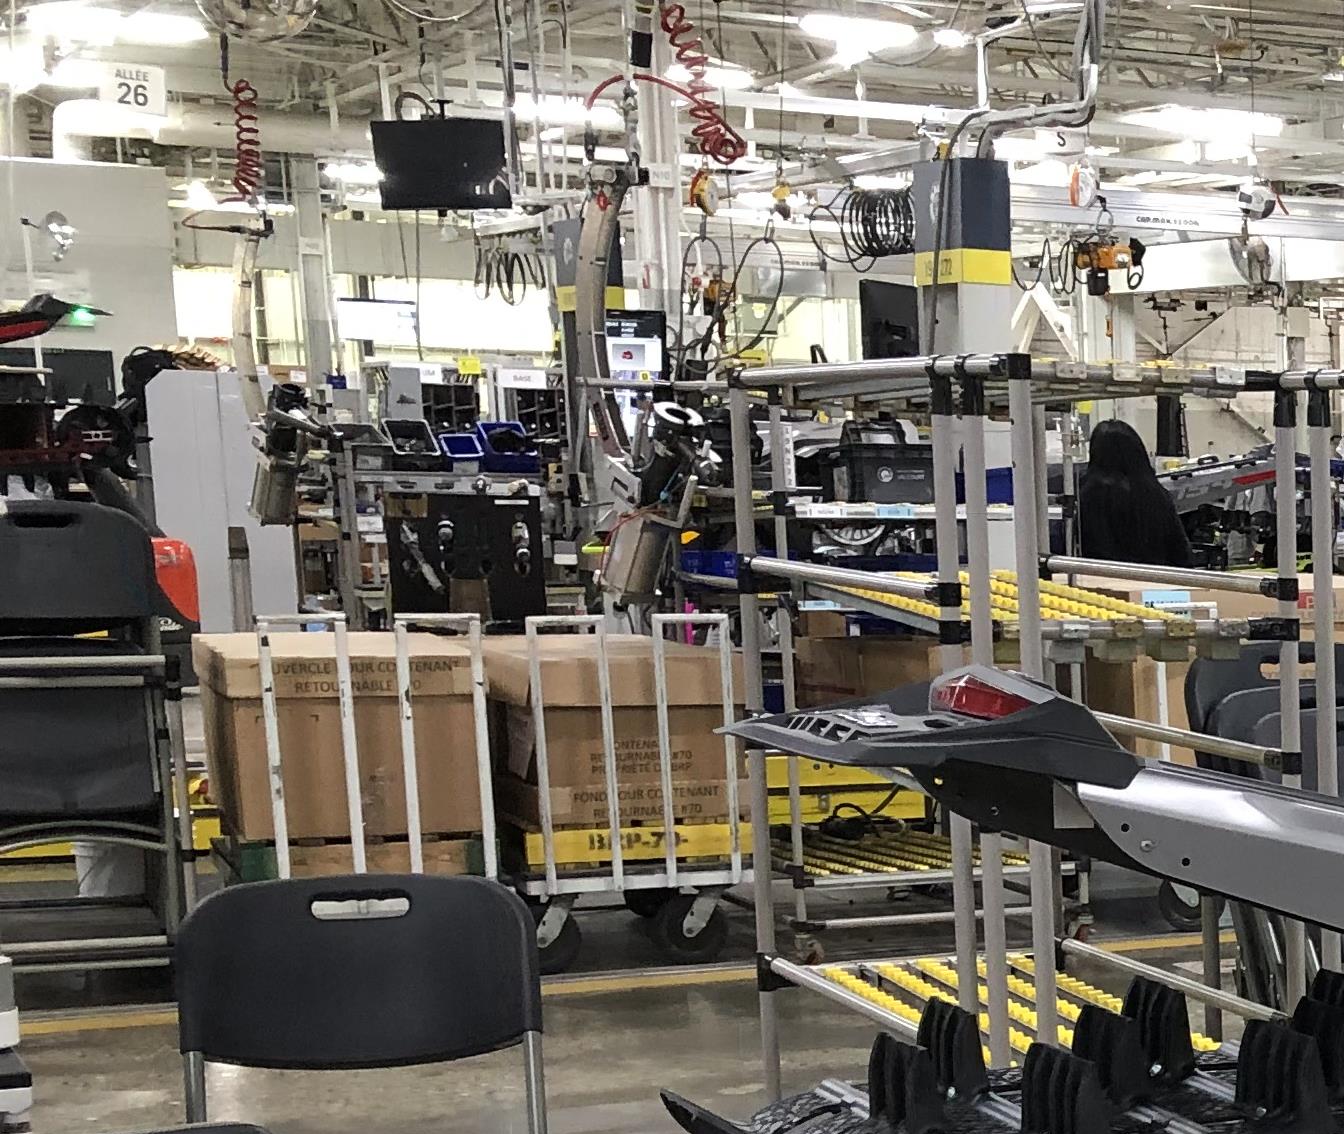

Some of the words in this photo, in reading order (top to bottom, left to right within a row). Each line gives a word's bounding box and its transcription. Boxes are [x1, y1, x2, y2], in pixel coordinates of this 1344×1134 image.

[117, 82, 149, 106] 26
[378, 660, 459, 673] COTENANT
[294, 678, 392, 693] RETOUNABLE
[647, 784, 720, 801] COTENANT
